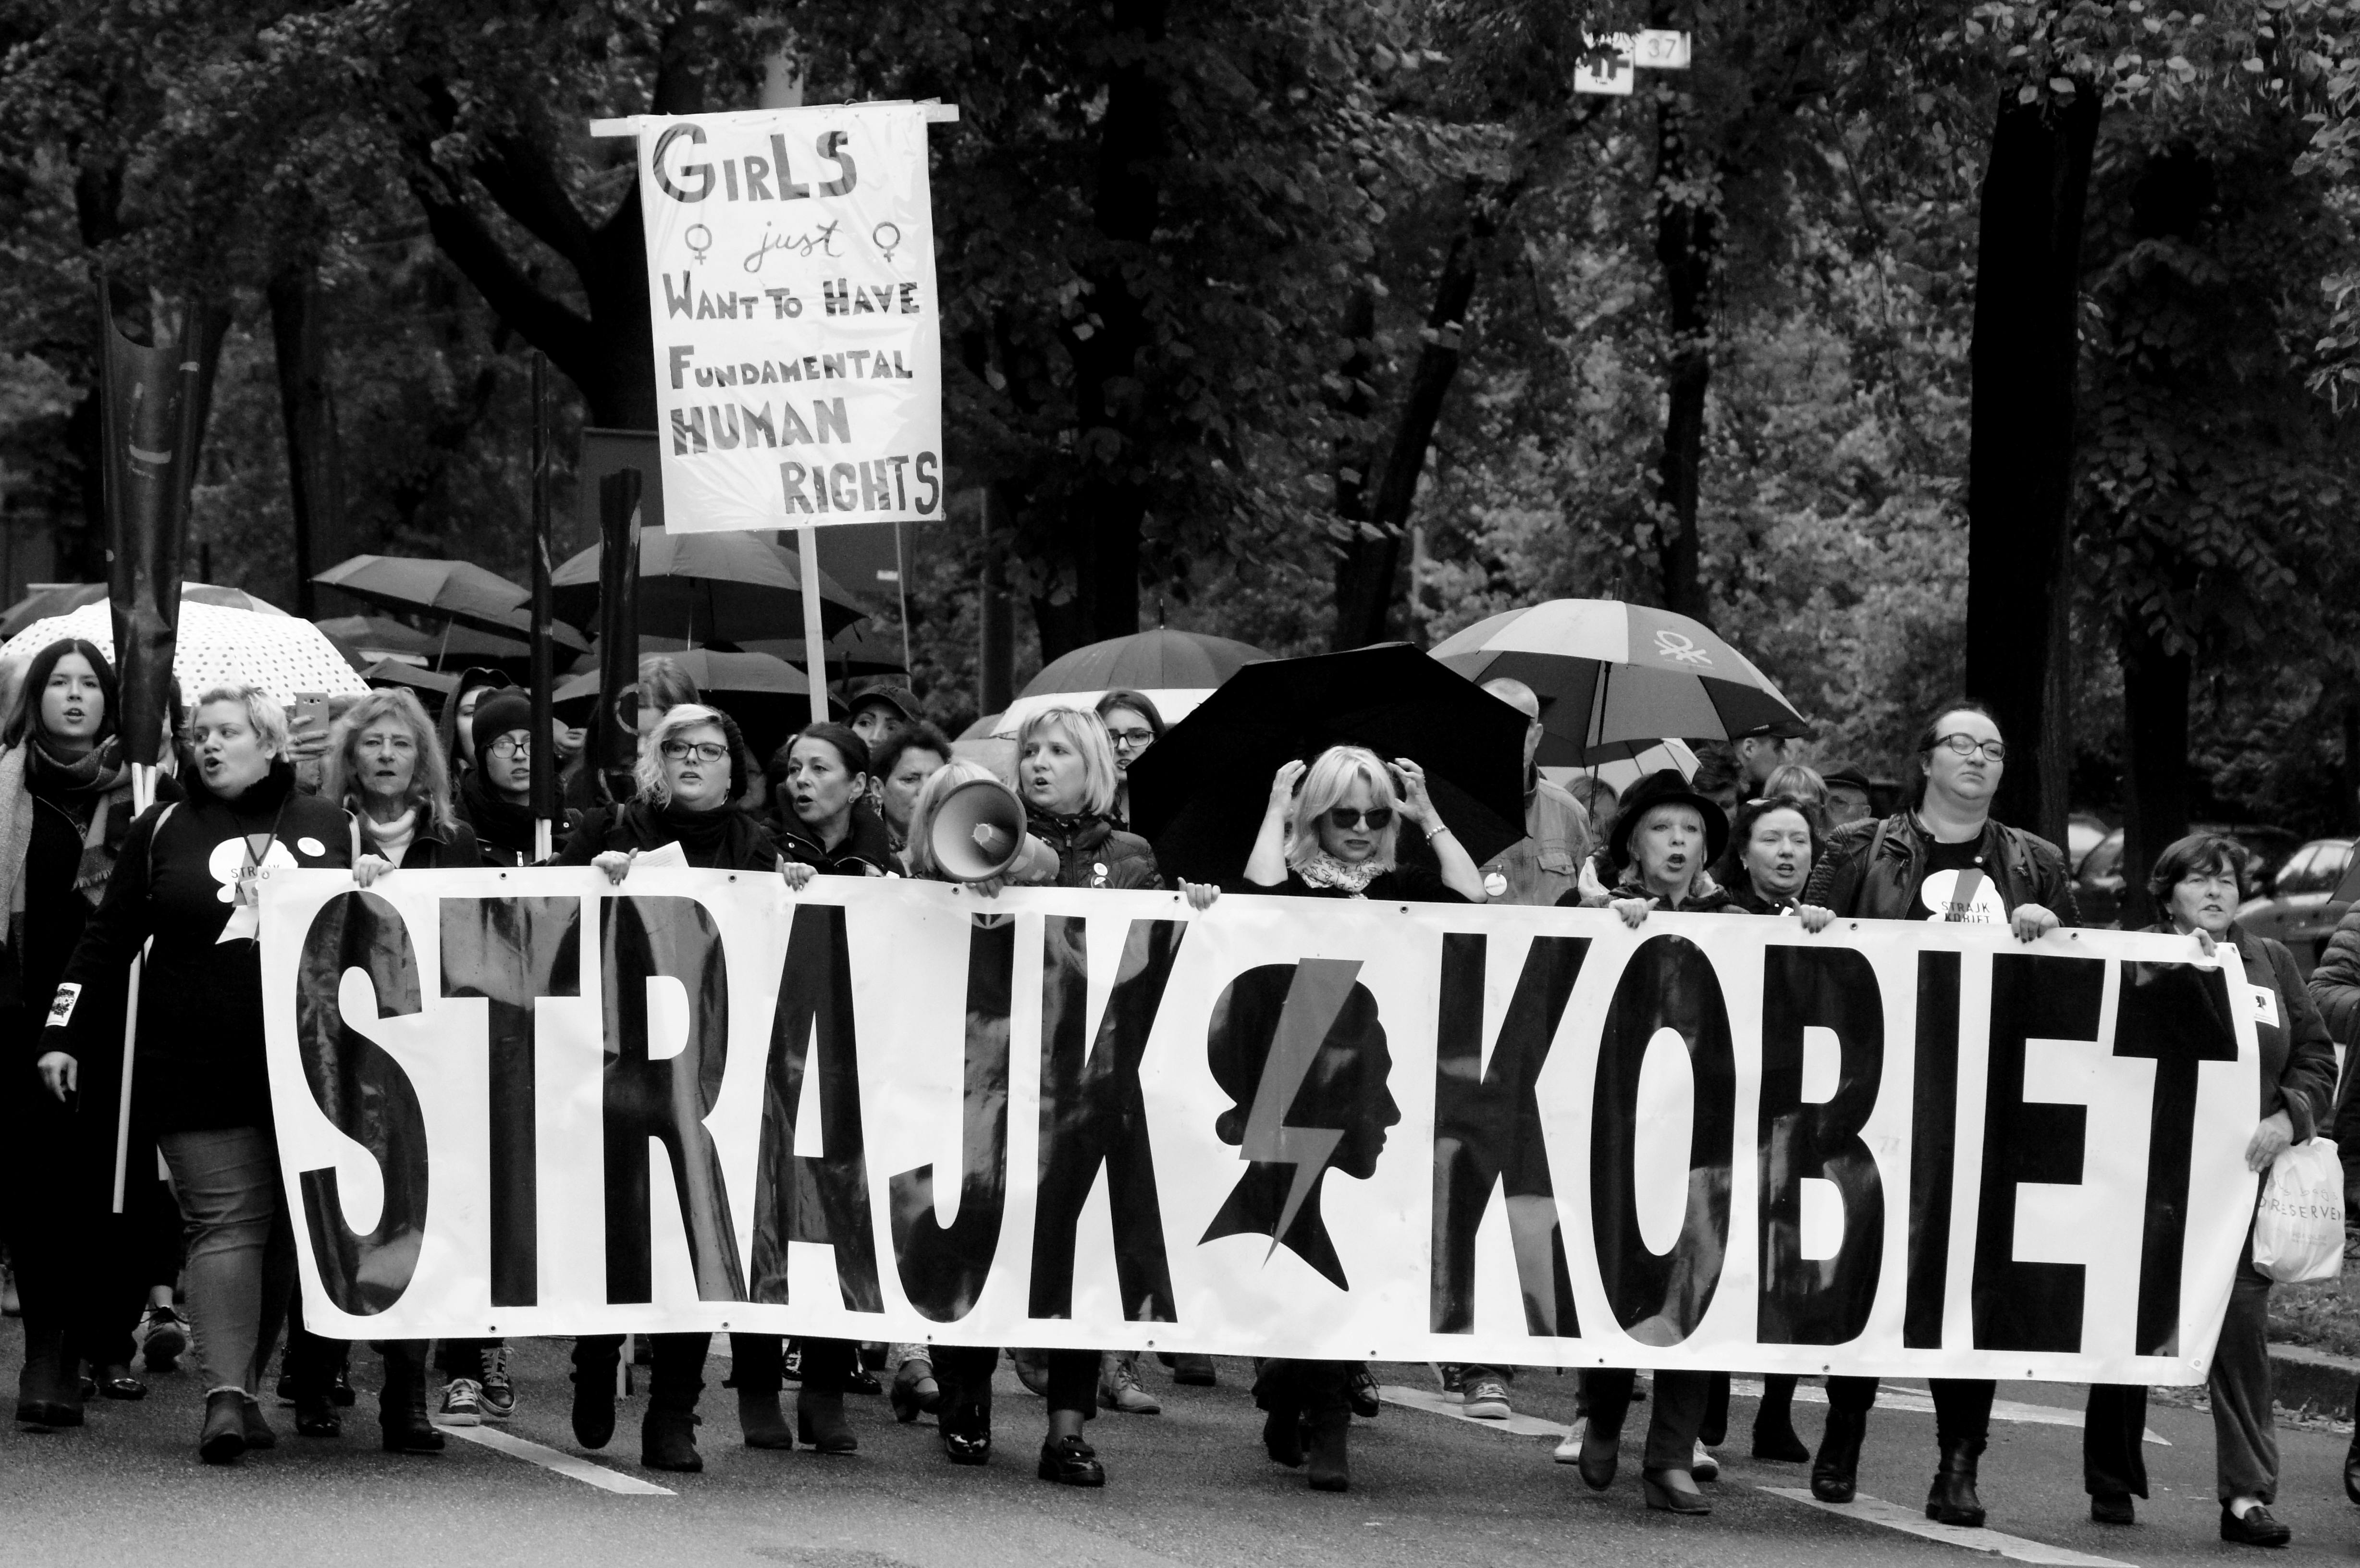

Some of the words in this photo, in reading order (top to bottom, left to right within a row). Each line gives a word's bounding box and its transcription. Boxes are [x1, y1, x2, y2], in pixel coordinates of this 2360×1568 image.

[1648, 37, 1676, 59] 37
[653, 123, 857, 203] GIRLS
[744, 220, 844, 273] just
[662, 270, 758, 320] WANT
[765, 288, 803, 319] TO
[823, 278, 920, 317] HAVE
[668, 345, 913, 390] FUNDAMENTAL
[670, 397, 851, 456] HUMAN
[780, 451, 940, 515] RIGHTS
[1942, 901, 1991, 913] STRAJK
[296, 891, 1188, 1323] STRAJK
[1430, 932, 2238, 1358] KOBIET
